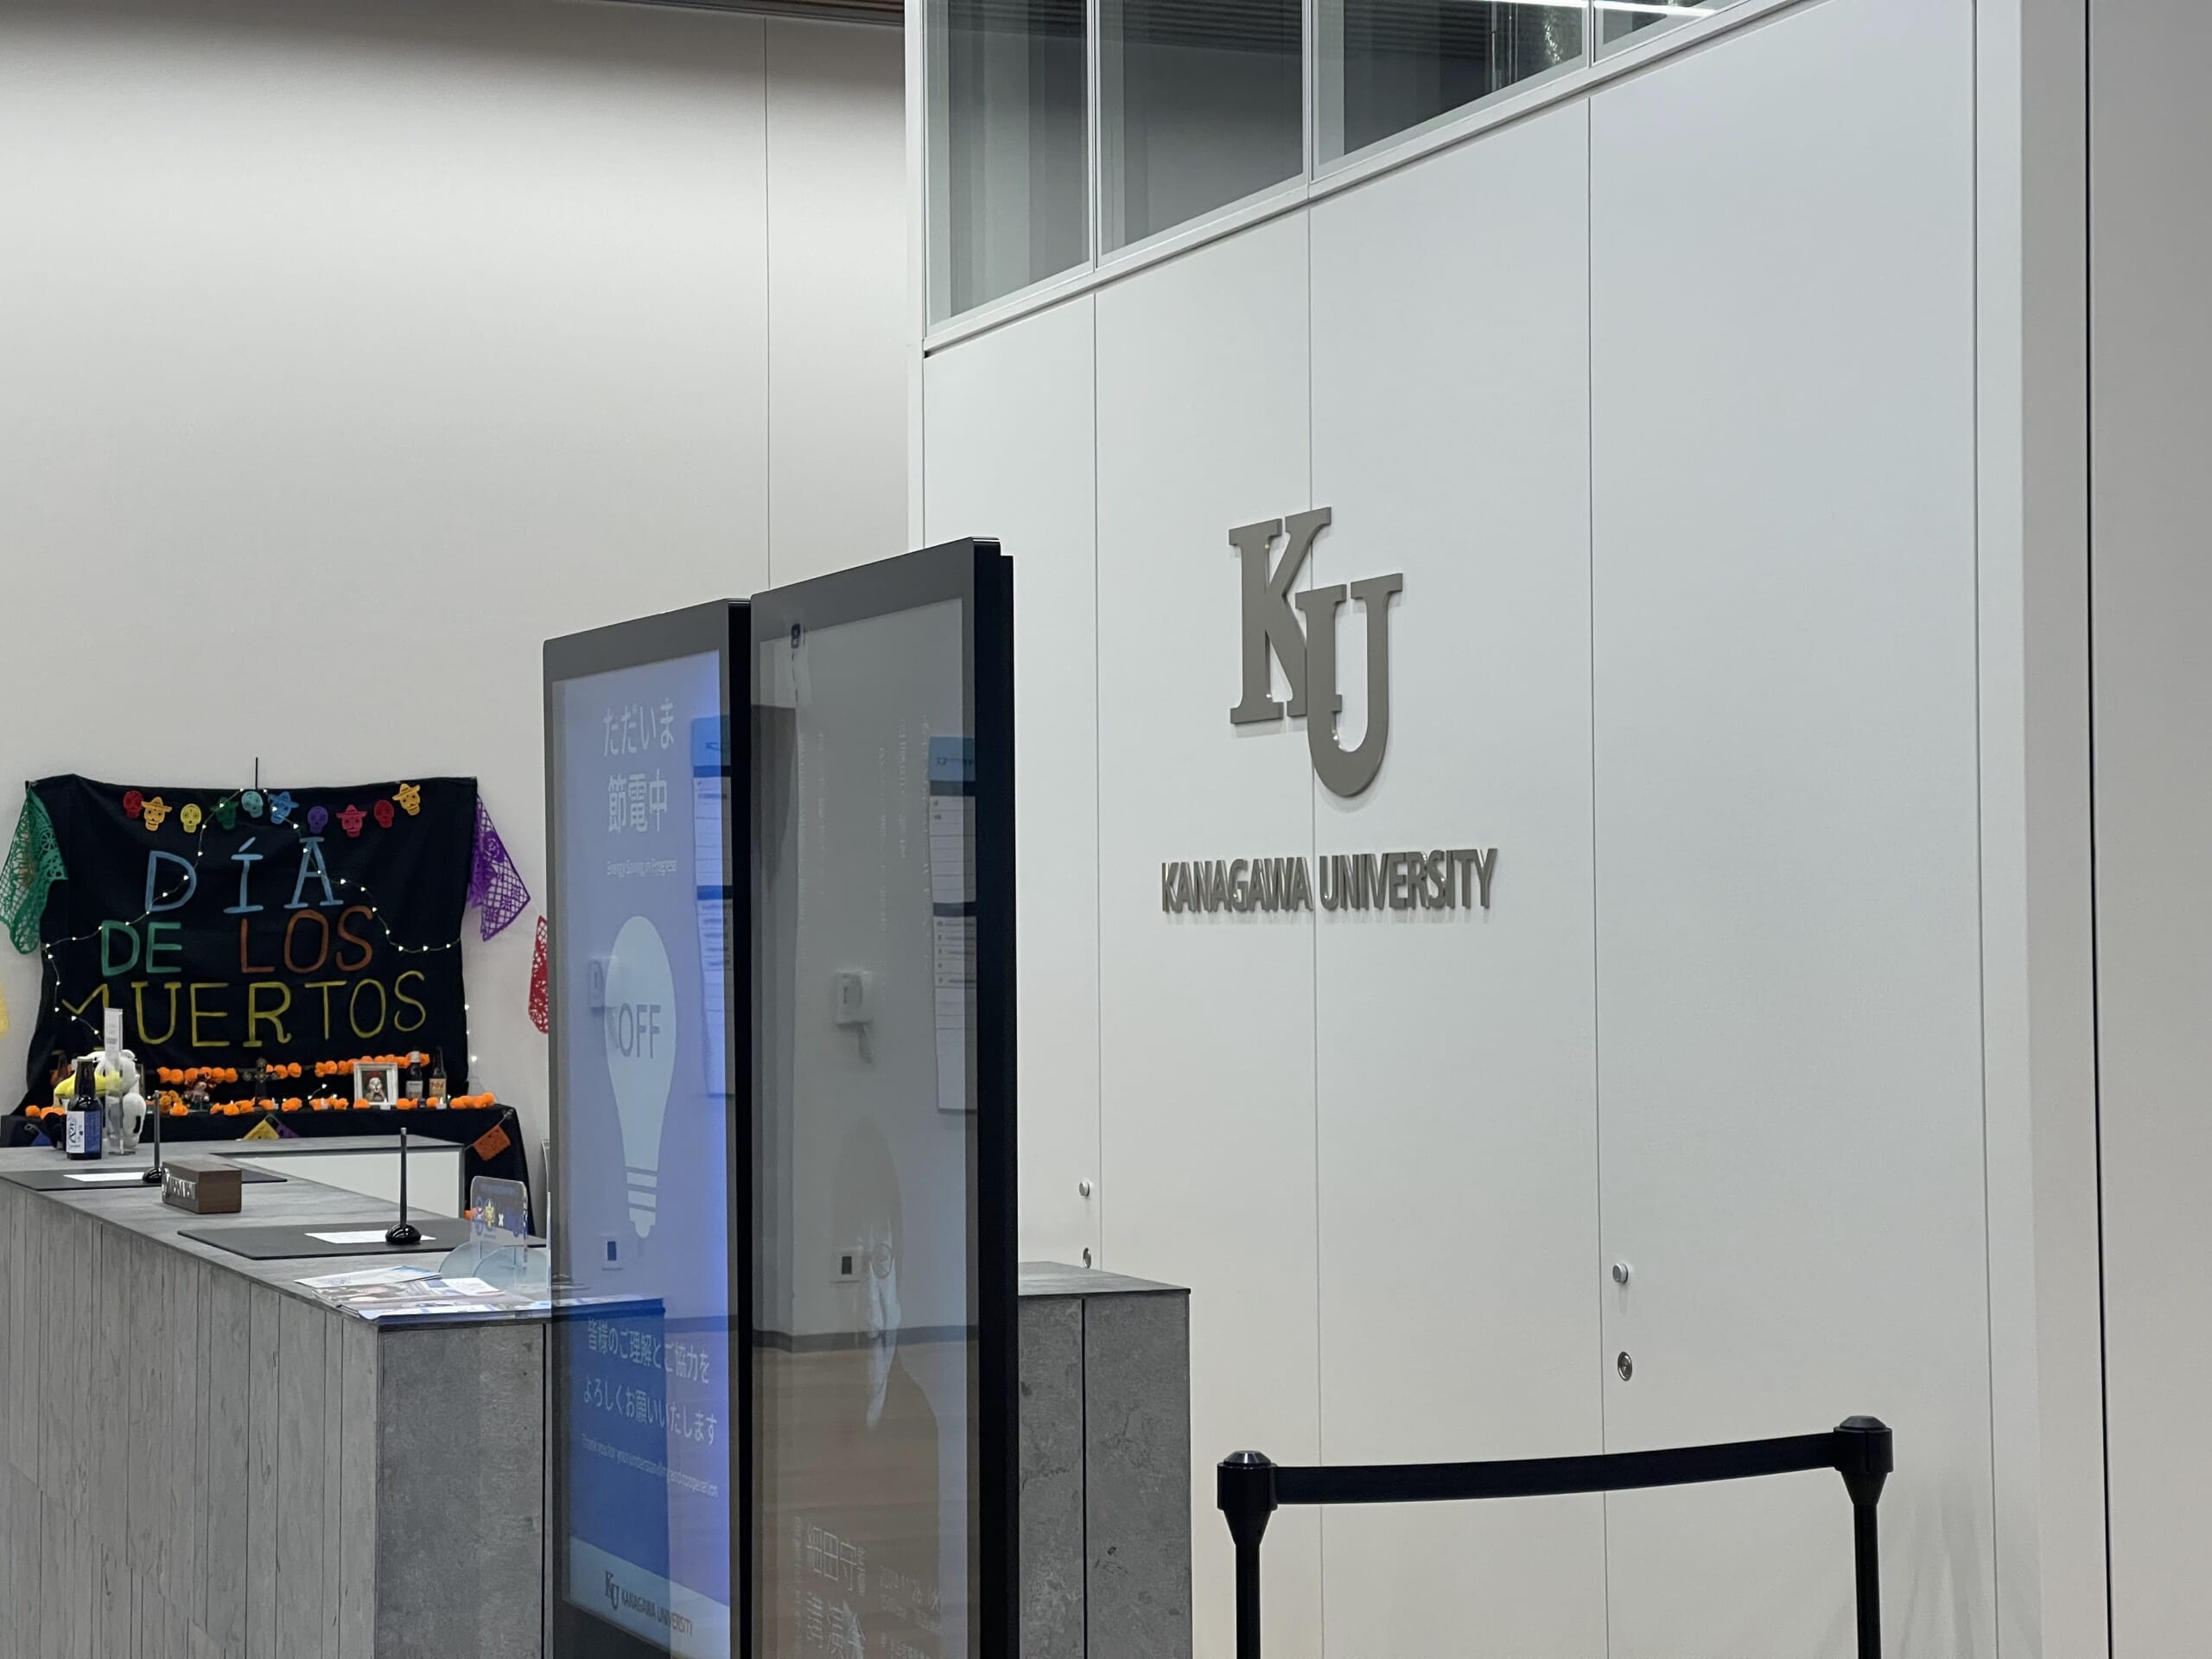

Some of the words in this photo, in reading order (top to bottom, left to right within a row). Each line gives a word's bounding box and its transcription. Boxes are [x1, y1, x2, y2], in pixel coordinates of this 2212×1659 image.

[1229, 506, 1403, 798] KU
[604, 697, 674, 757] ただいま
[608, 768, 668, 832] 節電中
[145, 836, 344, 913] DÍA
[1162, 857, 1314, 913] KANAGAWA
[1319, 848, 1498, 910] UNIVERSITY
[101, 919, 182, 977] DE
[240, 906, 373, 974] LOS
[619, 1002, 661, 1058] OFF
[582, 1374, 718, 1446] よろしくお願いいたします
[605, 1571, 620, 1611] KU
